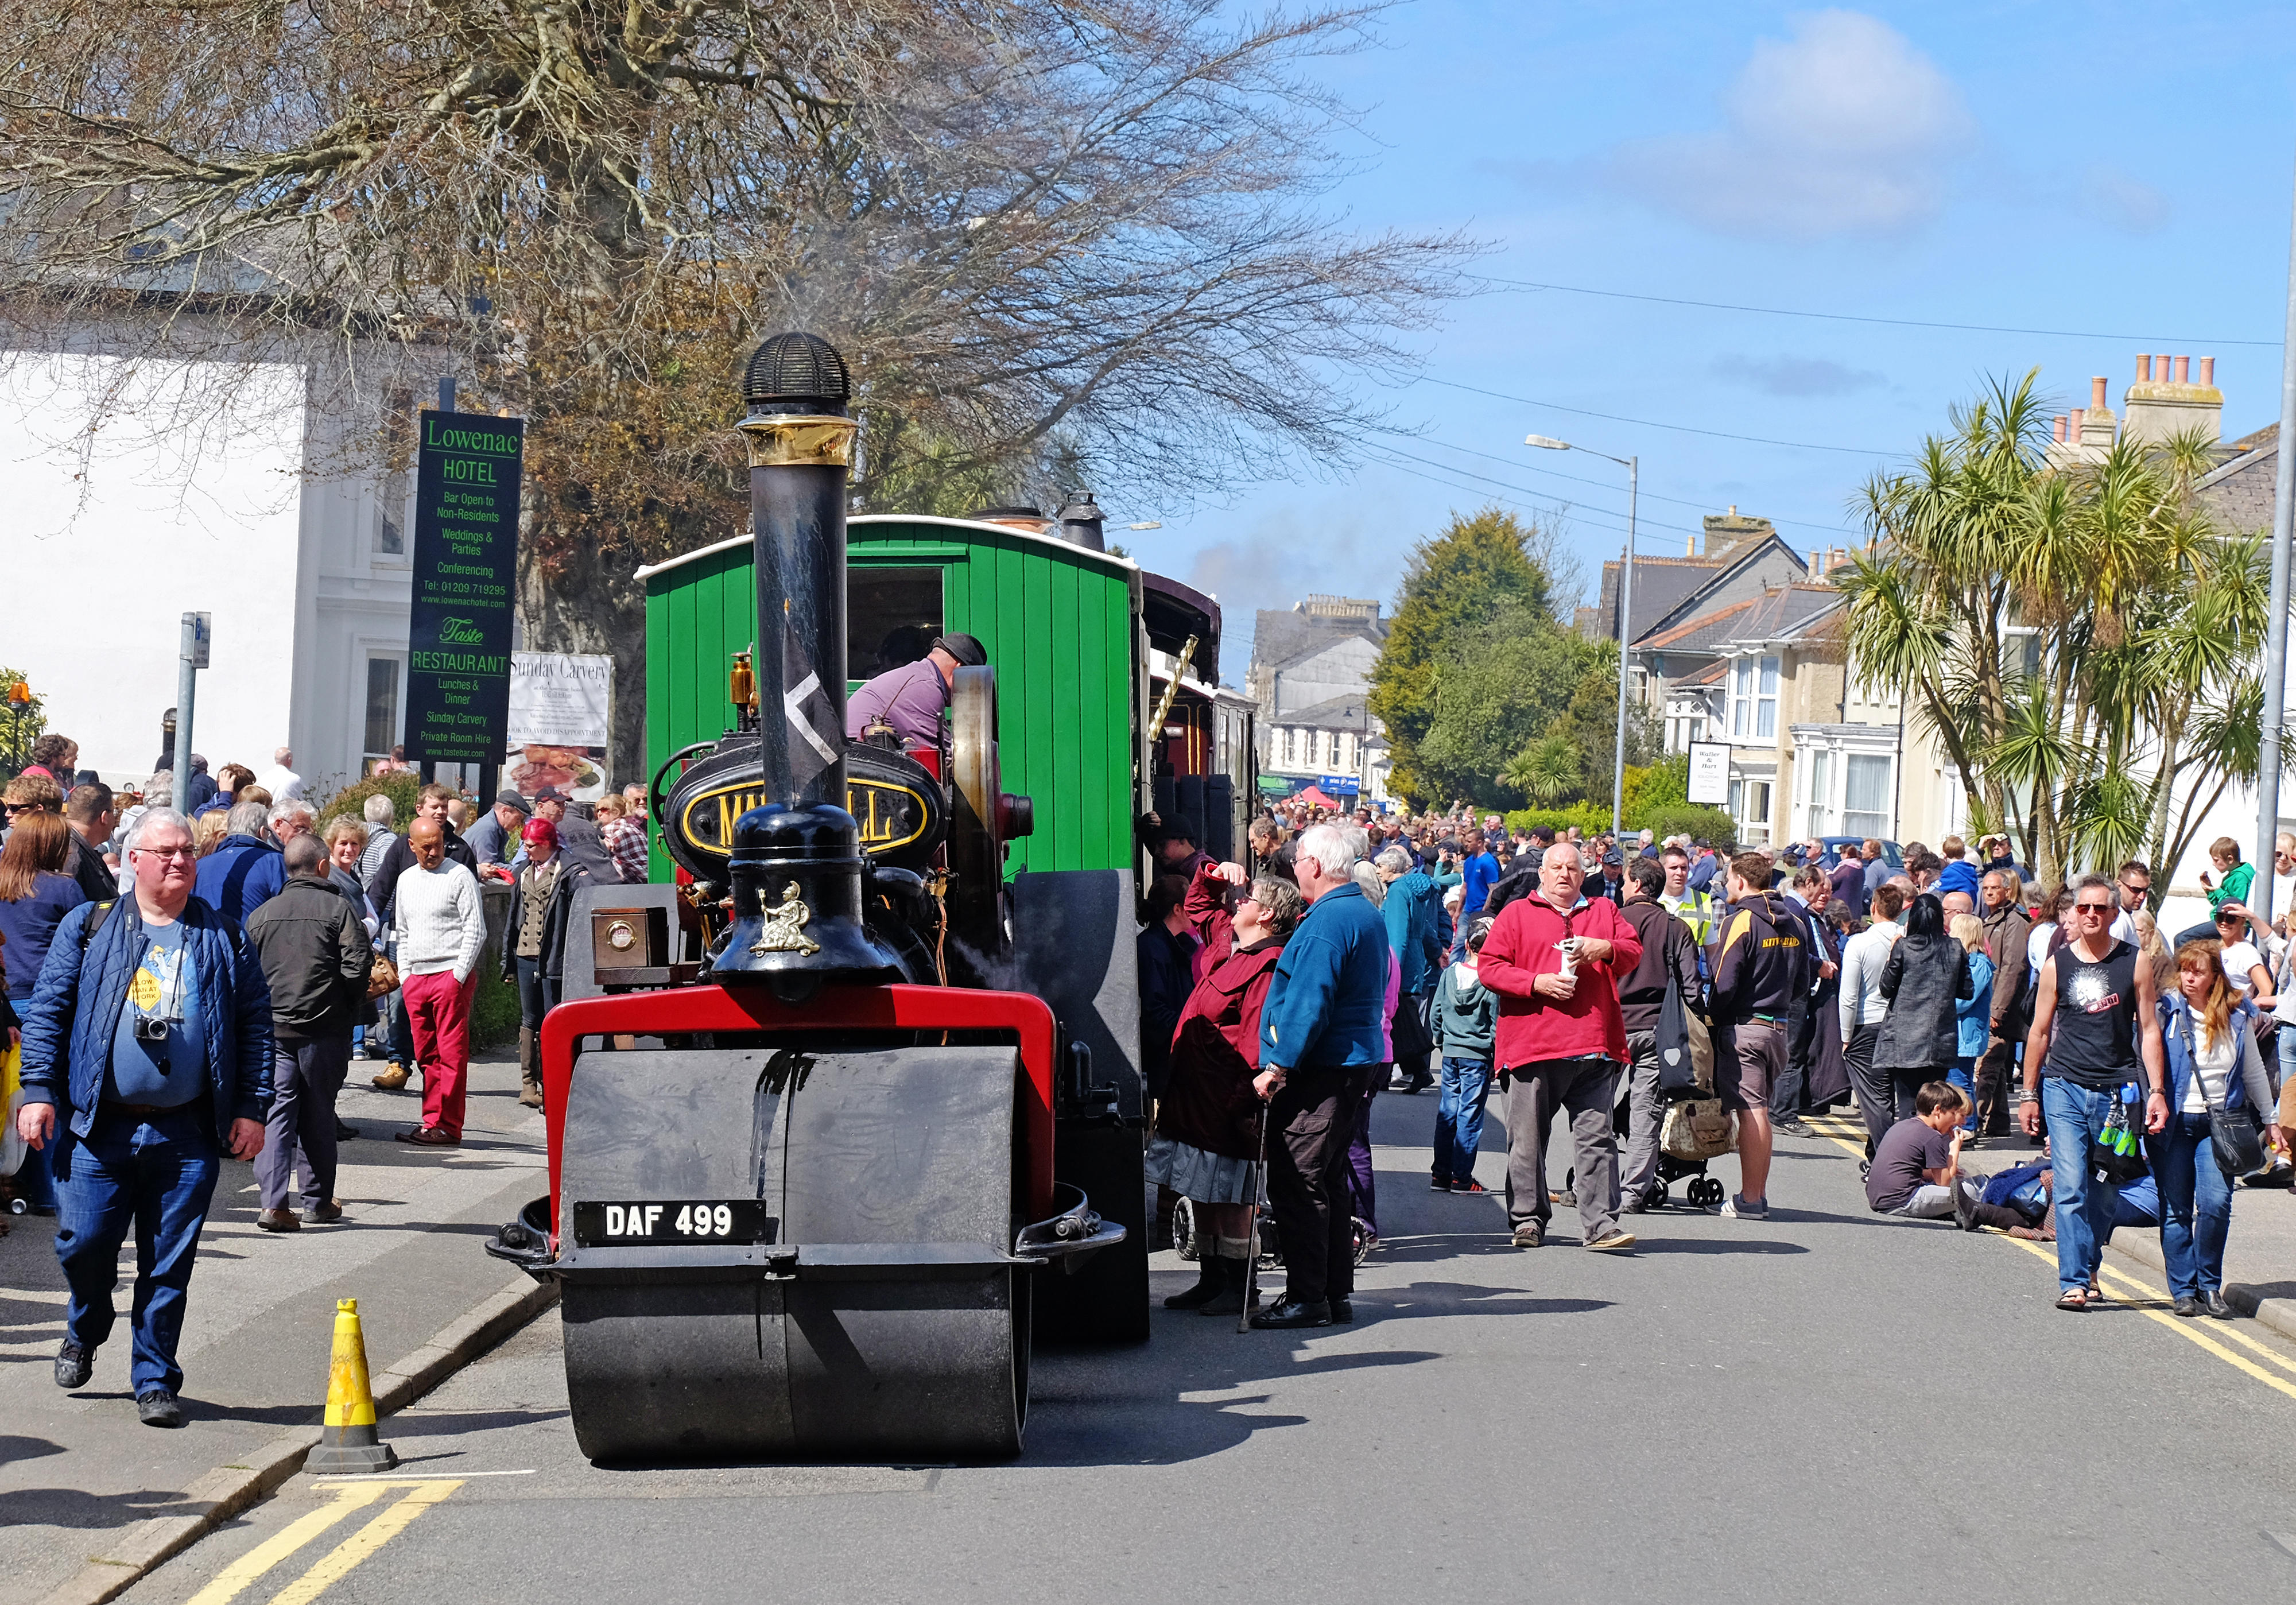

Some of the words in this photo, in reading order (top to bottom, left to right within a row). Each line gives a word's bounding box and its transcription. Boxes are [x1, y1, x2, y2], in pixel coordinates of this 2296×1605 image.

[426, 420, 518, 453] Lowenac
[444, 459, 497, 483] HOTEL
[444, 491, 458, 503] Bar
[461, 493, 483, 506] Open
[486, 495, 494, 506] to
[437, 507, 499, 522] Non-Residents
[442, 528, 483, 544] Weddings
[486, 532, 493, 542] &
[452, 544, 481, 556] Parties
[438, 561, 494, 578] Conferencing
[424, 580, 439, 591] Tel:
[441, 581, 470, 593] 01209
[472, 584, 506, 595] 719295
[421, 596, 506, 608] www.lowenachotel.com
[439, 617, 483, 643] Taste
[413, 652, 507, 673] RESTAURANT
[510, 654, 556, 685] Sunday
[560, 656, 606, 688] Carvery
[438, 678, 471, 690] Lunches
[472, 680, 479, 691] &
[445, 693, 471, 704] Dinner
[426, 711, 455, 724] Sunday
[457, 712, 487, 726] Carvery
[421, 731, 448, 742] Private
[451, 733, 472, 743] Room
[475, 734, 491, 744] Hire
[553, 728, 605, 737] DISAPPOINTMENT
[425, 747, 484, 758] www.tastebar.com
[606, 1205, 663, 1236] DAF
[675, 1205, 732, 1236] 499
